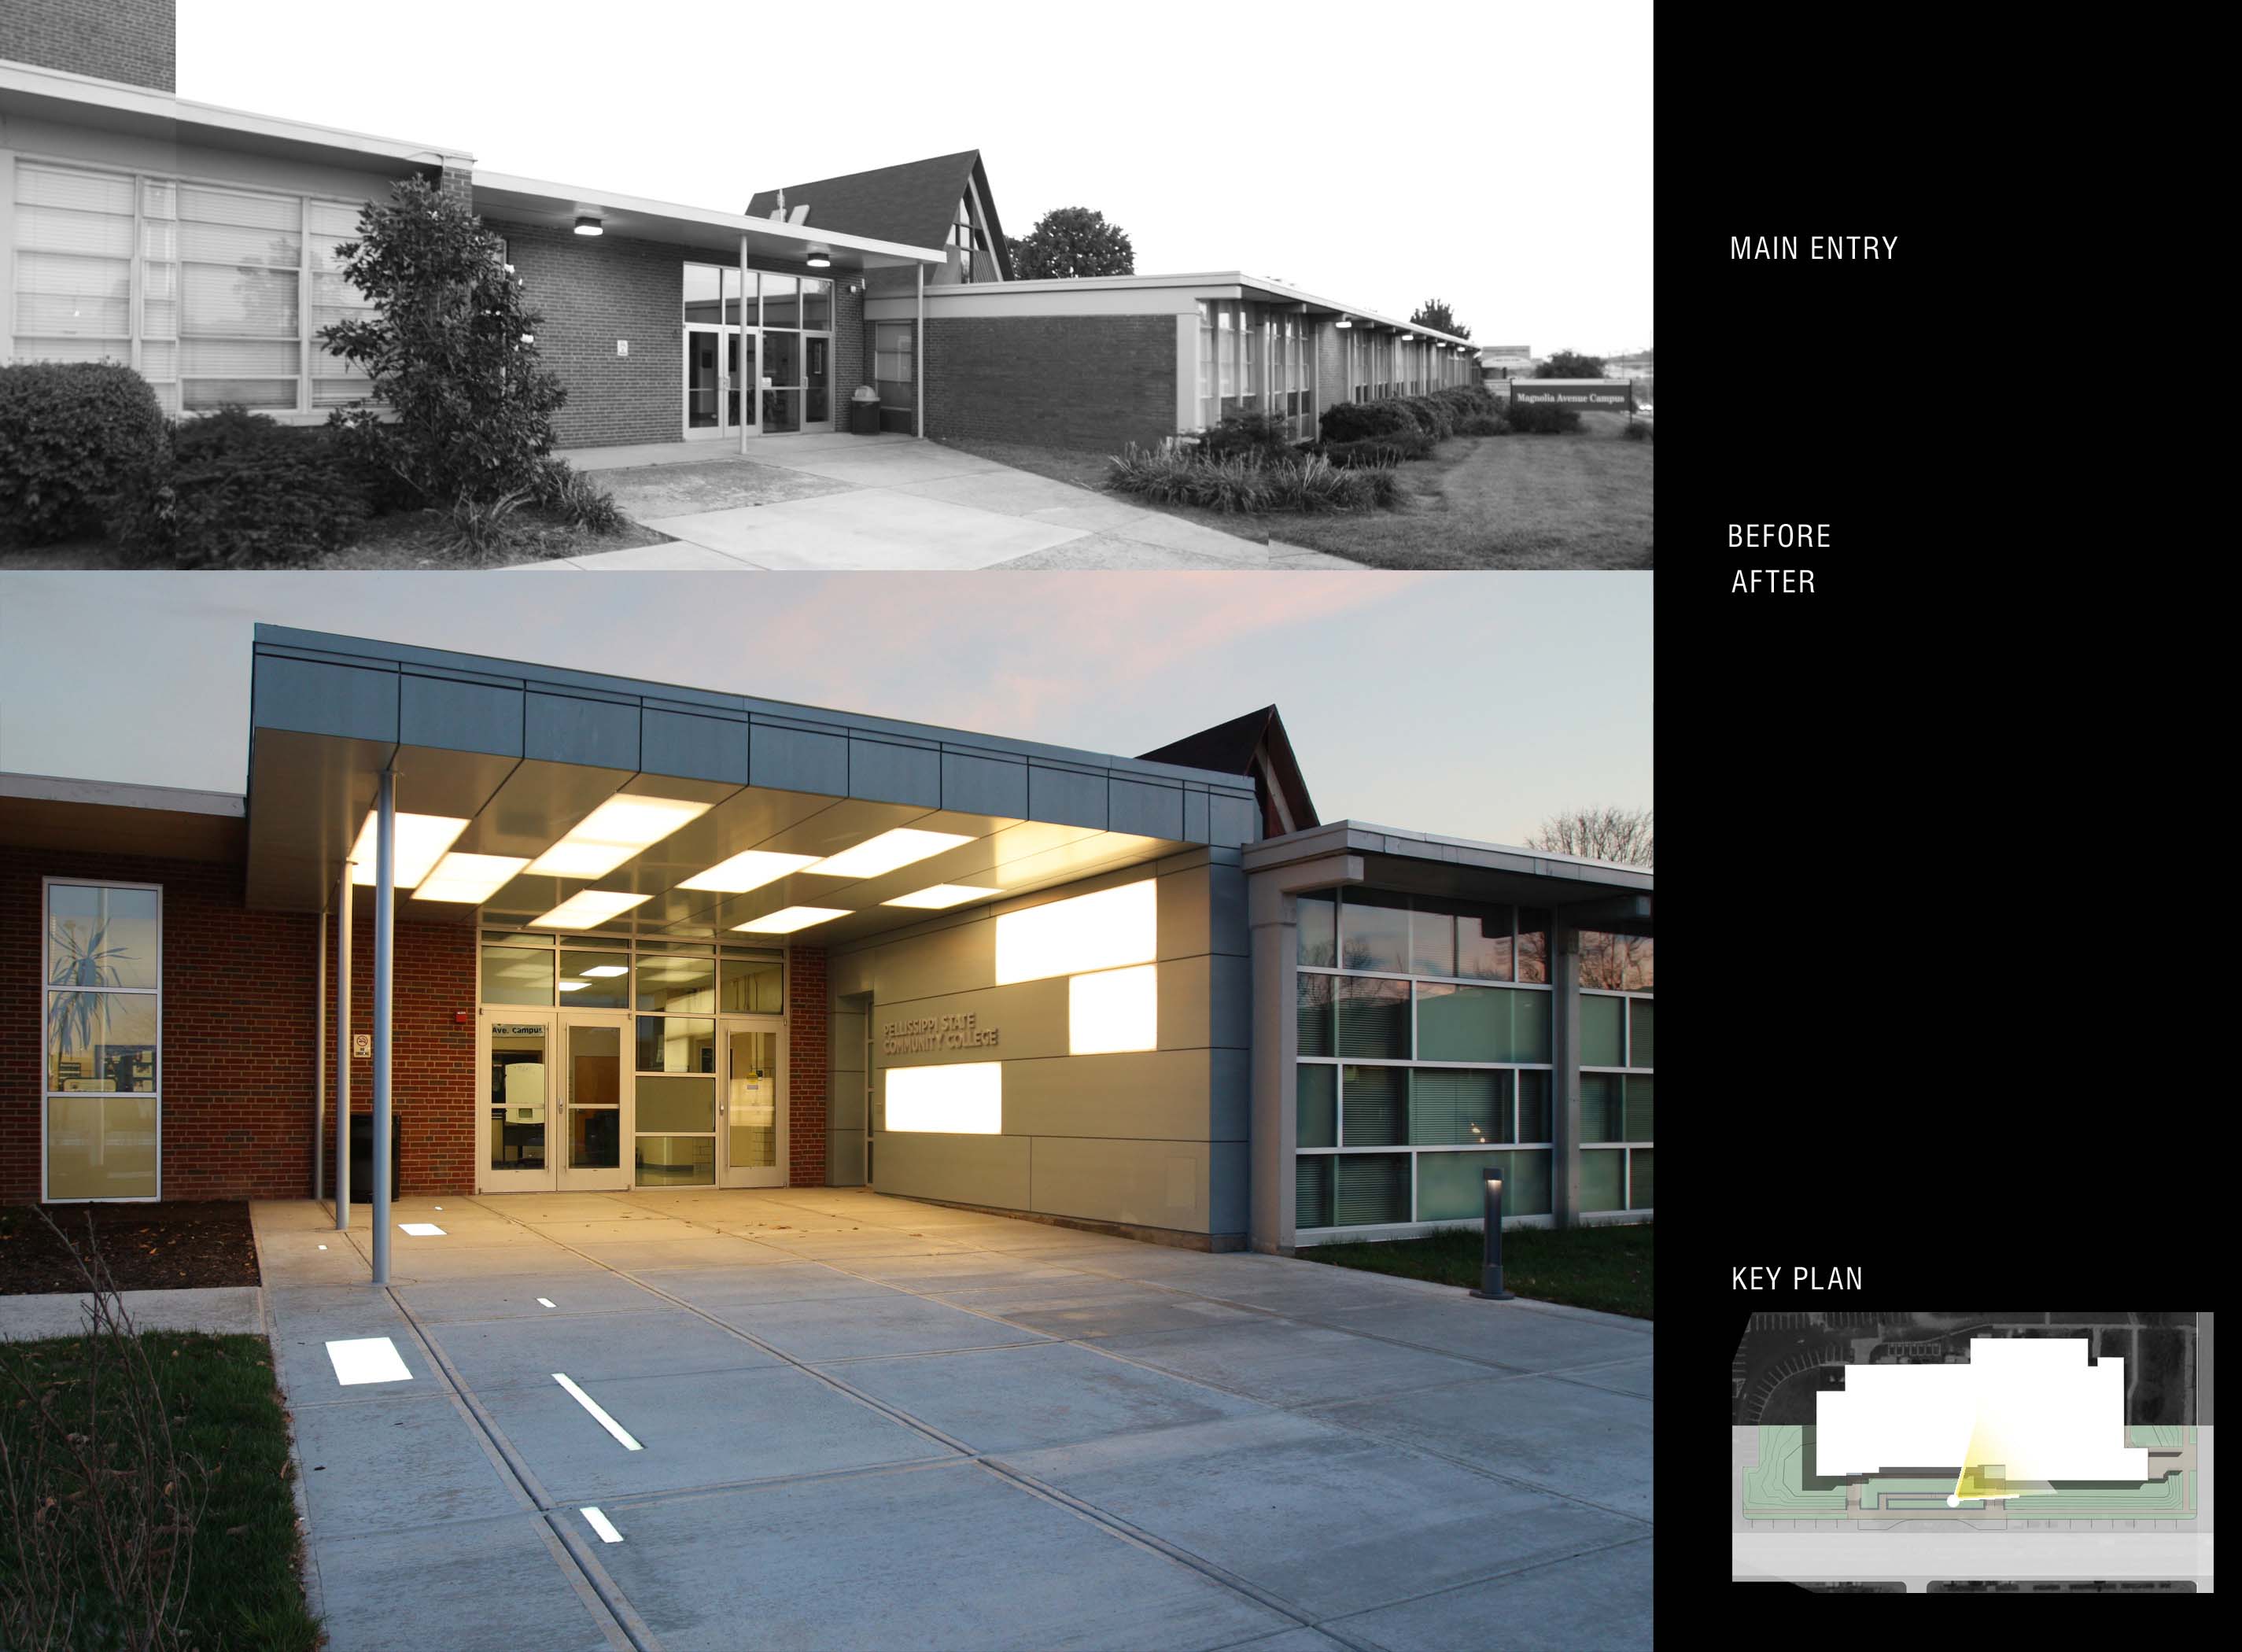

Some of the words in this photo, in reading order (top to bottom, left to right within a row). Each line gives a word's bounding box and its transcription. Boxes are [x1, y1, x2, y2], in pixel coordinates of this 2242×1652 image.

[1517, 393, 1554, 404] Magnolia
[1556, 393, 1587, 403] Avenue
[1589, 393, 1625, 404] Campus
[883, 1018, 938, 1037] PELLISSIPPI
[942, 1012, 976, 1031] STATE
[883, 1034, 944, 1055] COMMUNITY
[947, 1028, 999, 1049] COLLEGE
